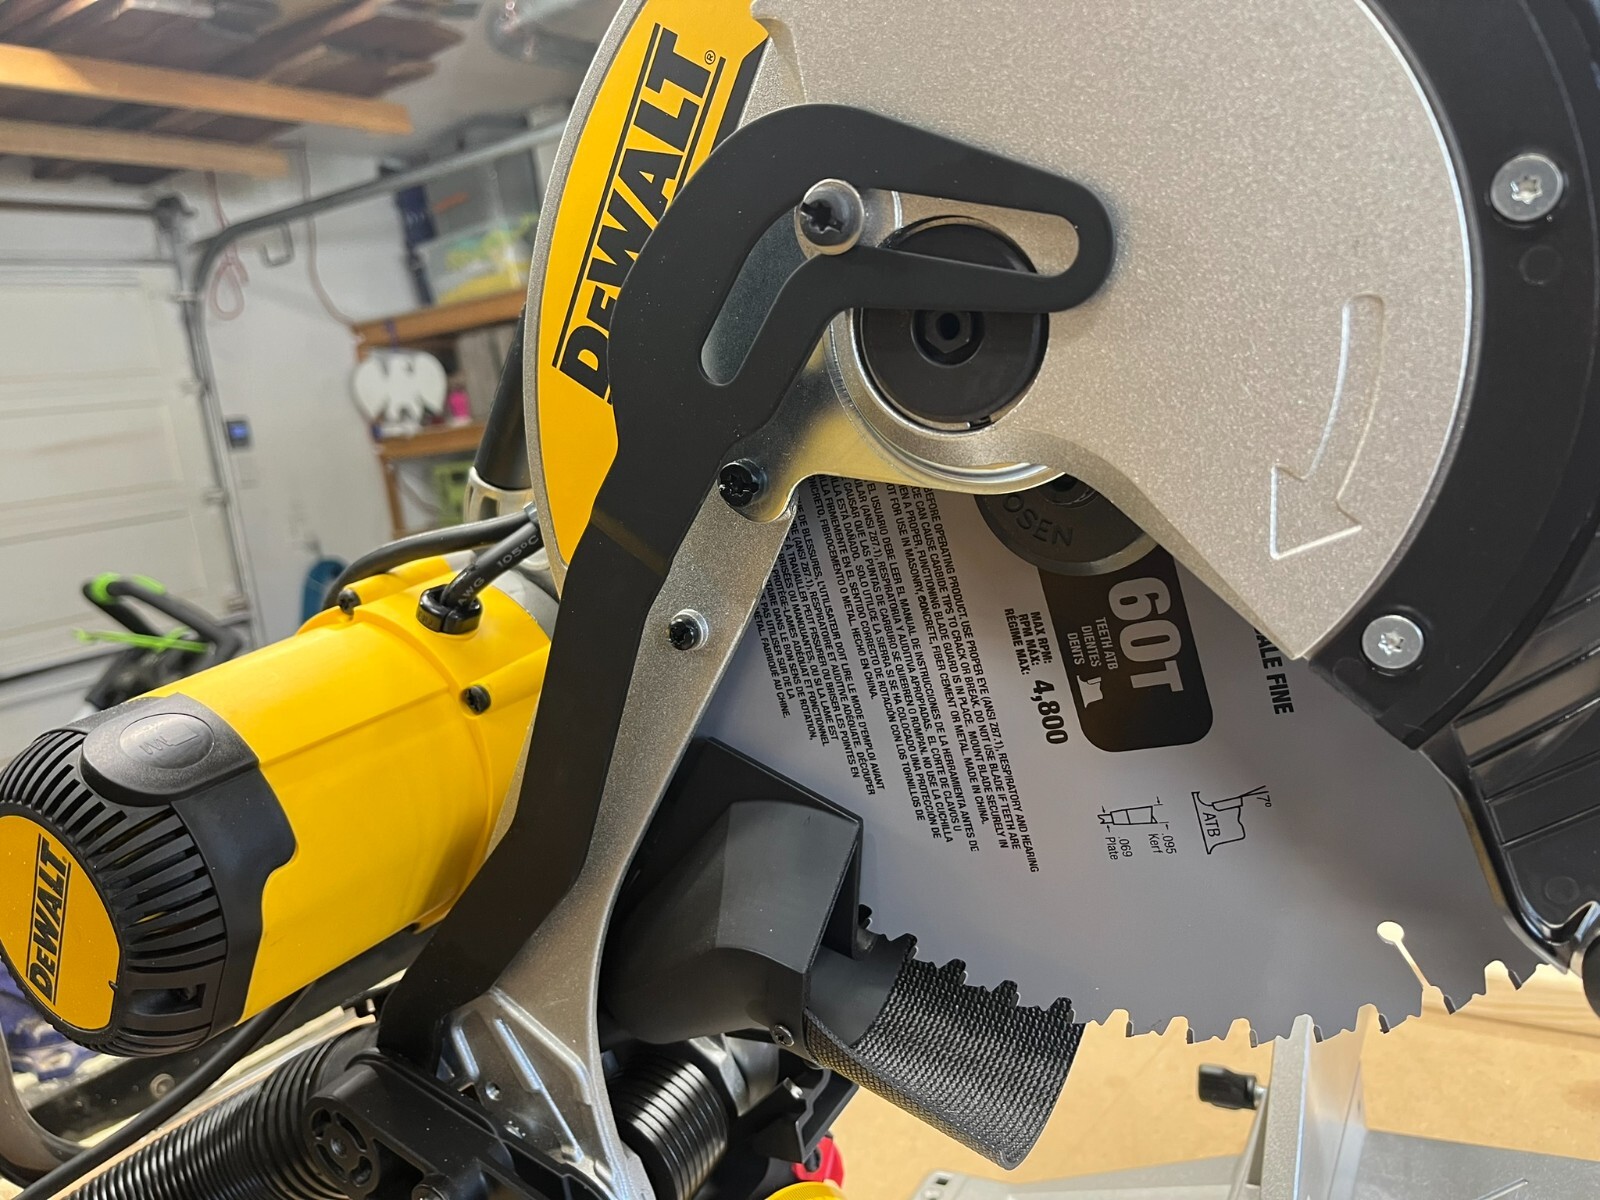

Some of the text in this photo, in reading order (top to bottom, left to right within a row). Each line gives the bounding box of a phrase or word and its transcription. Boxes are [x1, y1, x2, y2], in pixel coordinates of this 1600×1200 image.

[842, 481, 861, 519] CAUSAR
[869, 495, 889, 535] USUARIO
[889, 496, 902, 516] FOR
[914, 499, 928, 520] CAN
[824, 496, 849, 555] FIRMEMENTE
[853, 518, 866, 539] QUE
[895, 516, 908, 537] USE
[920, 520, 937, 552] CAUSE
[858, 538, 872, 557] LAS
[881, 536, 896, 562] DEBE
[933, 522, 955, 574] OPERATING
[819, 518, 846, 587] FIBROCEMENTO
[850, 626, 867, 657] HECHO
[854, 563, 869, 588] SOLO
[864, 556, 882, 593] PUNTAS
[888, 561, 903, 585] LEER
[929, 552, 948, 593] CARBIDE
[848, 581, 867, 619] SENTIDO
[861, 588, 879, 622] UTILICE
[898, 597, 918, 637] MANUAL
[940, 593, 954, 614] TIPS
[859, 619, 880, 666] CORRECTO
[878, 607, 898, 651] CARBURO
[950, 628, 967, 660] CRACK
[960, 620, 973, 639] USE
[1004, 608, 1030, 675] RÉGIME MAX:
[1019, 613, 1041, 665] RPM MÁX:
[1031, 611, 1052, 664] MAX RPM:
[1081, 625, 1101, 667] DIENTES
[1095, 617, 1118, 670] TEETH ATB
[1109, 577, 1184, 693] 60T
[875, 635, 892, 668] SIERRA
[931, 644, 946, 672] FIBER
[965, 639, 984, 676] PROPER
[1067, 632, 1085, 665] DENTS
[894, 663, 914, 707] QUIEBREN
[914, 650, 942, 720] INSTRUCCIONES
[976, 676, 989, 695] EYE
[1254, 628, 1294, 714] ALE FINE
[876, 560, 902, 624] RESPIRATORIA
[896, 632, 916, 674] AUDITIVA
[929, 746, 946, 776] CORTE
[942, 789, 960, 824] CLAVOS
[916, 549, 941, 610] FUNCTIONING
[933, 610, 950, 641] BLADE
[942, 641, 959, 673] GUARD
[967, 730, 984, 763] MOUNT
[976, 763, 993, 793] BLADE
[985, 793, 1005, 837] SECURELY
[938, 671, 957, 709] CEMENT
[833, 641, 847, 662] DOIT
[840, 662, 853, 682] LIRE
[849, 694, 865, 720] MODE
[869, 761, 885, 790] AVANT
[895, 705, 916, 752] COLOCADO
[1030, 680, 1068, 744] 4,800
[889, 723, 902, 742] CON
[977, 724, 991, 743] NOT
[894, 743, 908, 760] LOS
[908, 752, 922, 771] UNA
[983, 743, 996, 761] USE
[900, 760, 921, 808] TORNILLOS
[924, 770, 938, 788] USE
[941, 747, 967, 809] HERRAMIENTA
[962, 756, 978, 783] MADE
[988, 762, 1005, 792] BLADE
[997, 752, 1022, 812] RESPIRATORY
[933, 801, 954, 842] CUCHILLA
[959, 809, 975, 838] ANTES
[999, 802, 1015, 830] TEETH
[1014, 813, 1028, 833] AND
[1203, 812, 1220, 837] ATB
[1007, 831, 1021, 849] ARE
[1020, 833, 1039, 872] HEARING
[1105, 836, 1118, 860] Plate
[1118, 837, 1133, 857] .069
[1148, 833, 1163, 854] Kerf
[1161, 833, 1176, 854] .095
[29, 837, 67, 1002] DEWALT
